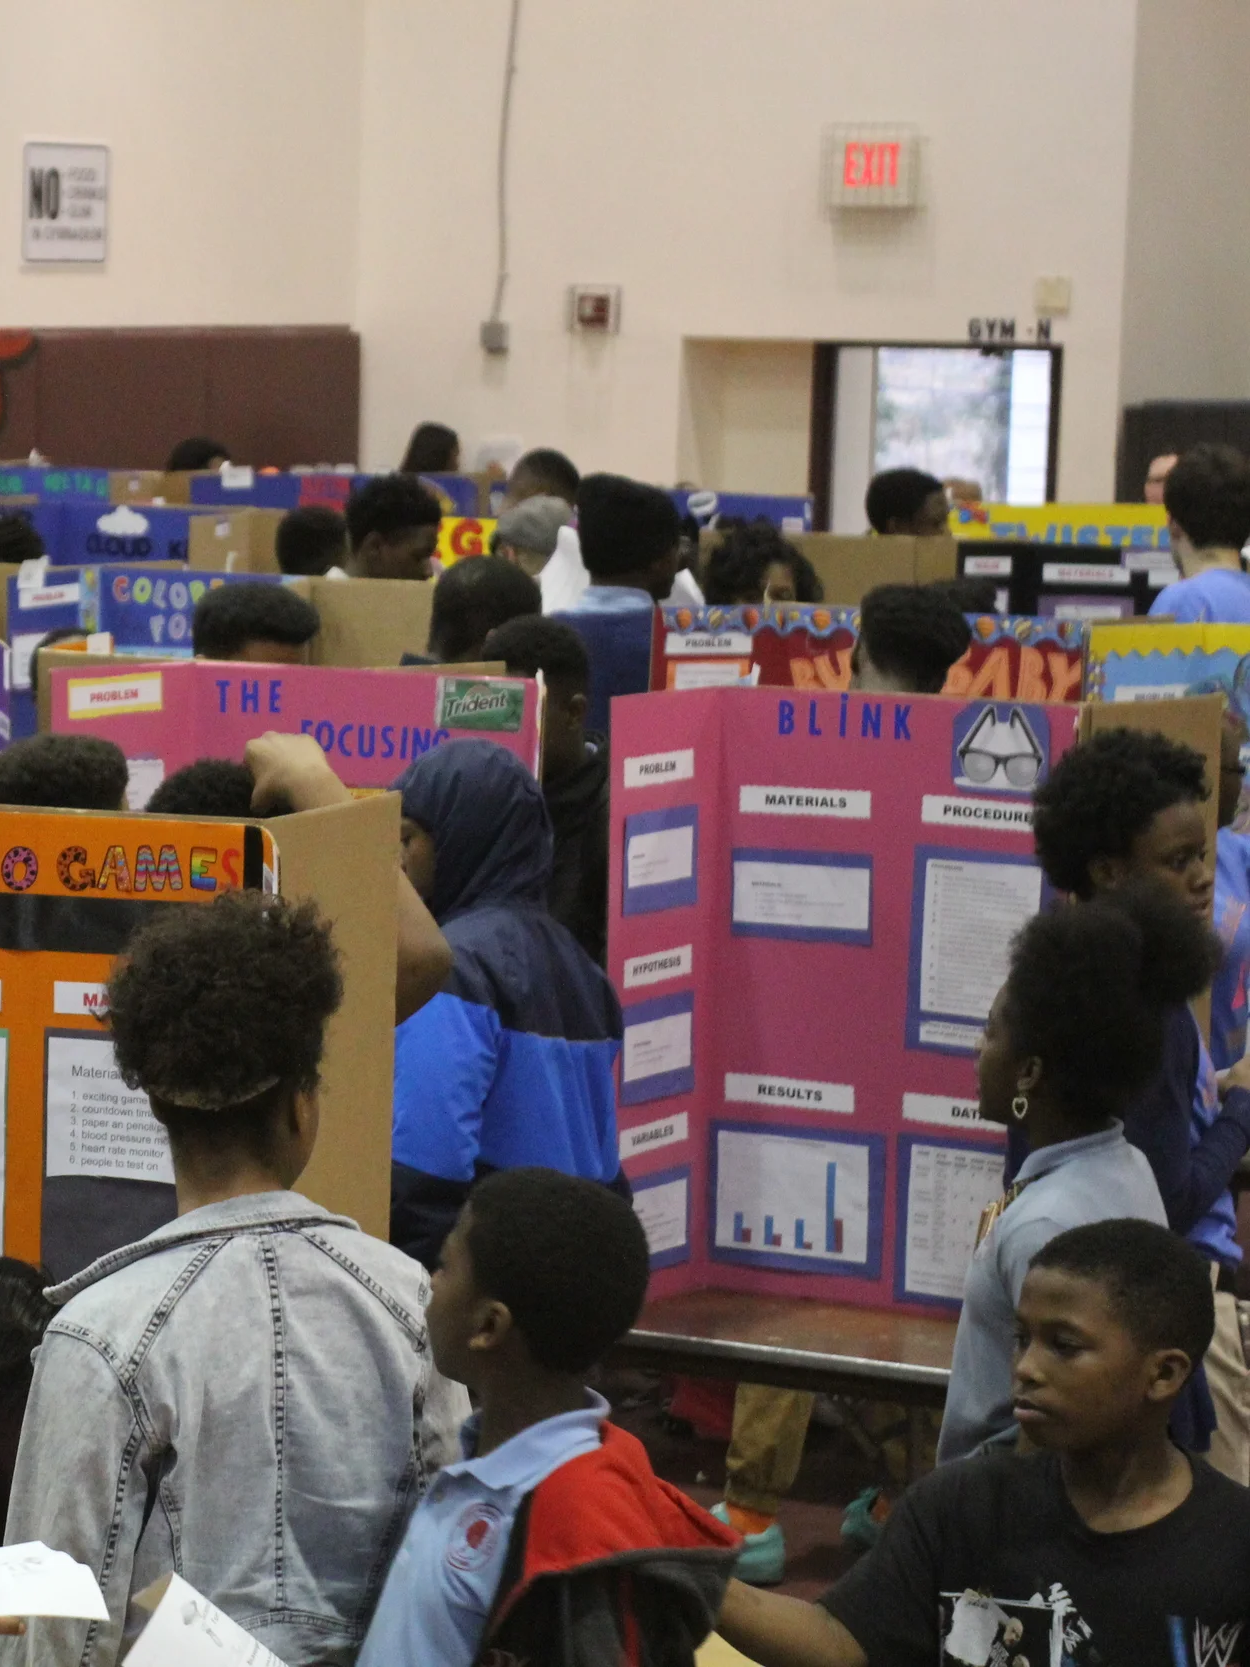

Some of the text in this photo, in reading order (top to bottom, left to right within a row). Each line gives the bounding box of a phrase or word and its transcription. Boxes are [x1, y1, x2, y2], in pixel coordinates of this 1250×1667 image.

[844, 142, 900, 187] EXIT
[29, 166, 60, 220] NO
[89, 689, 139, 704] PROBLEM
[215, 679, 283, 713] THE
[445, 689, 508, 718] Trident
[638, 760, 677, 775] PROBLEM
[764, 793, 848, 809] MATERIALS
[56, 843, 240, 893] GAMES
[632, 955, 682, 977] HYPOTHESIS
[82, 1093, 119, 1104] exciting
[757, 1083, 824, 1102] RESULTS
[82, 1105, 133, 1117] countdown
[81, 1119, 109, 1129] paper
[112, 1120, 124, 1129] an
[81, 1130, 108, 1140] blood
[110, 1132, 152, 1144] pressure
[631, 1124, 674, 1147] VARIABLES
[81, 1143, 106, 1153] heart
[108, 1145, 127, 1154] rate
[129, 1147, 164, 1158] monitor
[81, 1156, 113, 1168] people
[115, 1158, 124, 1168] to
[127, 1160, 144, 1170] test
[146, 1163, 159, 1171] on
